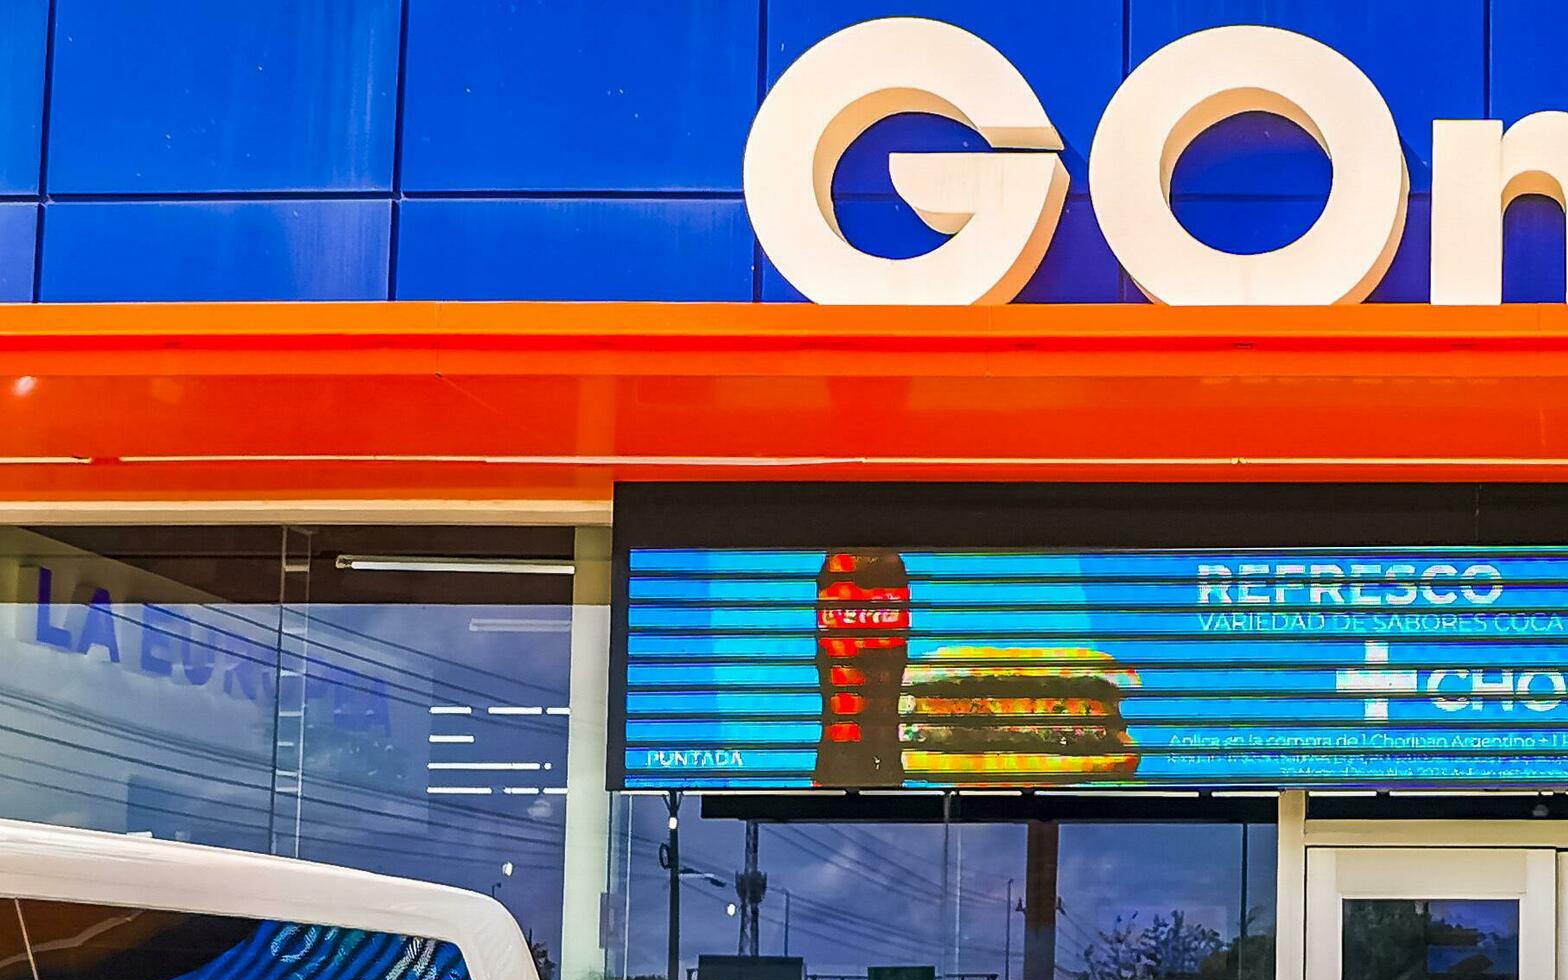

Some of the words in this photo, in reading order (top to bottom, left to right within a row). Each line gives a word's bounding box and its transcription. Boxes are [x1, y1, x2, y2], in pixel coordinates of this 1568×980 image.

[1197, 563, 1504, 605] REFRESCO
[36, 566, 120, 663] LA
[1198, 612, 1325, 633] VARIEDAD
[1335, 612, 1368, 632] DE
[1372, 612, 1488, 632] SABORES
[1493, 612, 1564, 632] COCA
